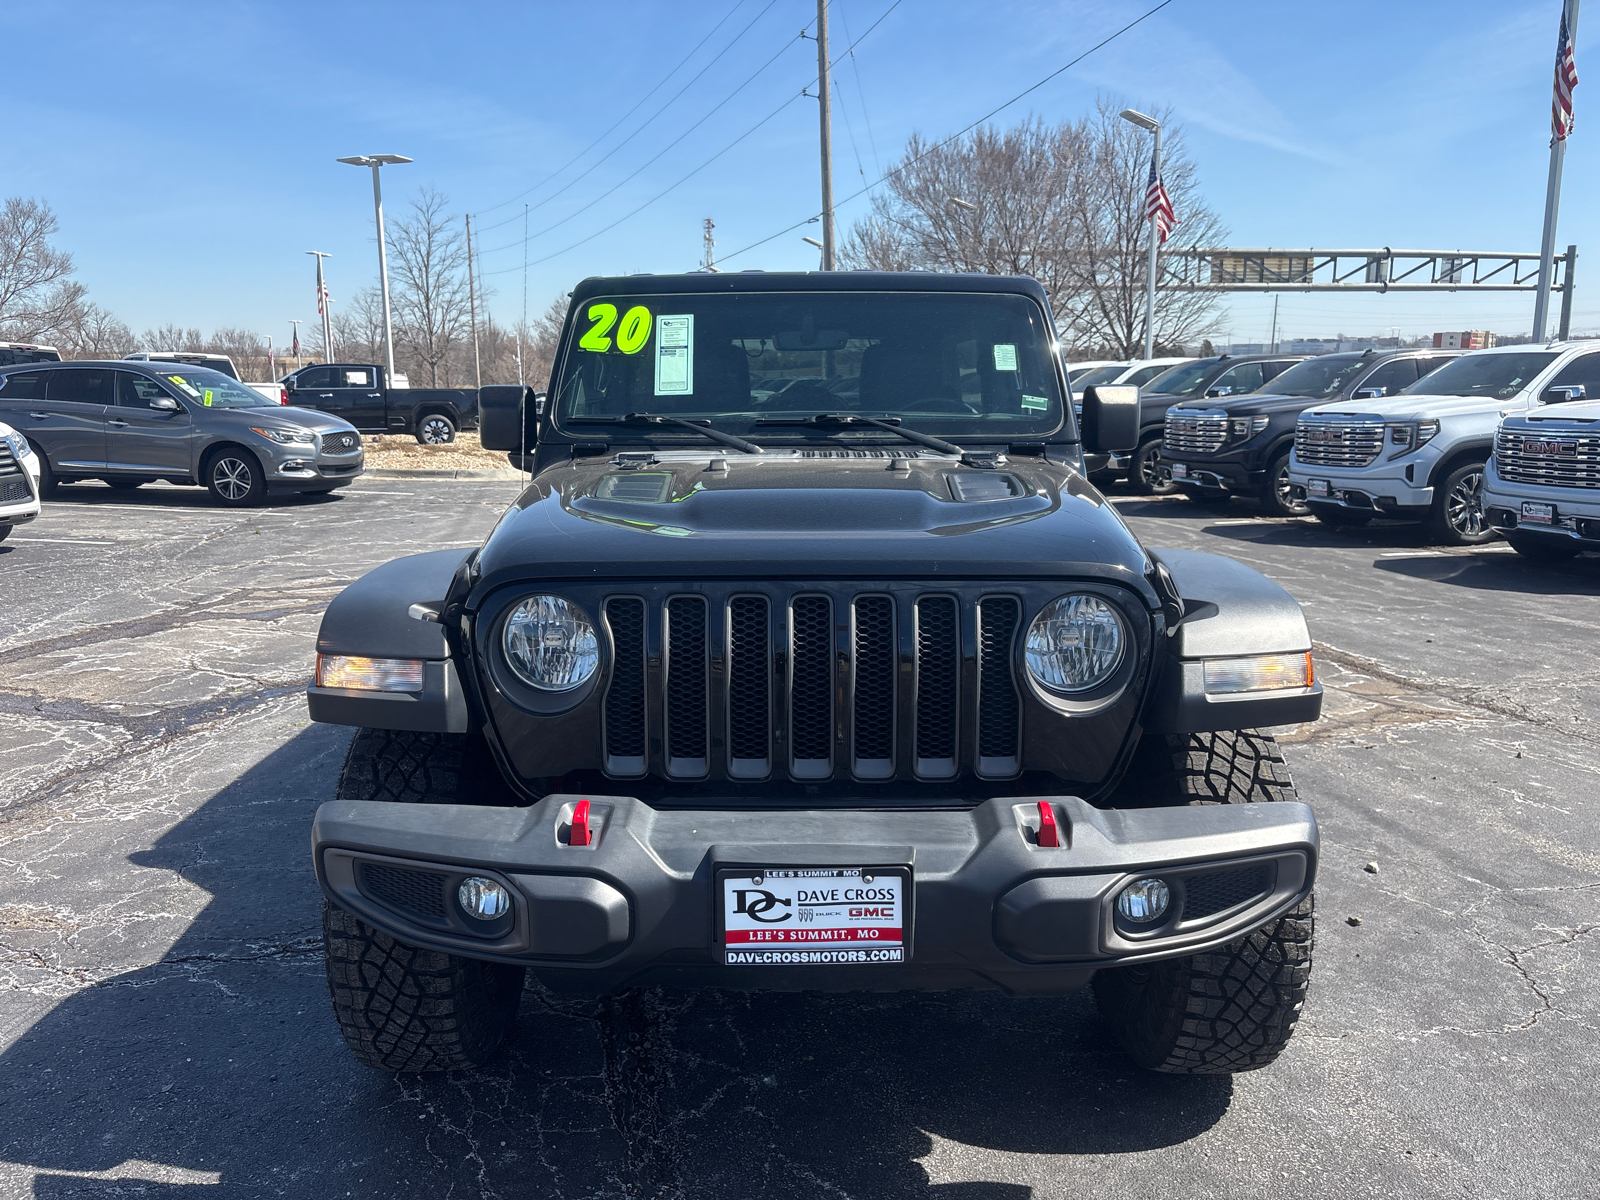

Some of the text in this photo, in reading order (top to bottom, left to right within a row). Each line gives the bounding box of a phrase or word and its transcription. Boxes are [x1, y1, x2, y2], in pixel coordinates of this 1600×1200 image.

[579, 303, 653, 355] 20
[1524, 441, 1576, 455] GMC
[766, 870, 795, 878] LEE'S
[797, 888, 895, 902] DAVE CROSS
[732, 889, 793, 923] DC
[849, 907, 894, 917] GMC
[749, 929, 880, 941] LEE'S SUMMIT, MO
[728, 950, 901, 963] DAVECROSSMOTORS.COM
